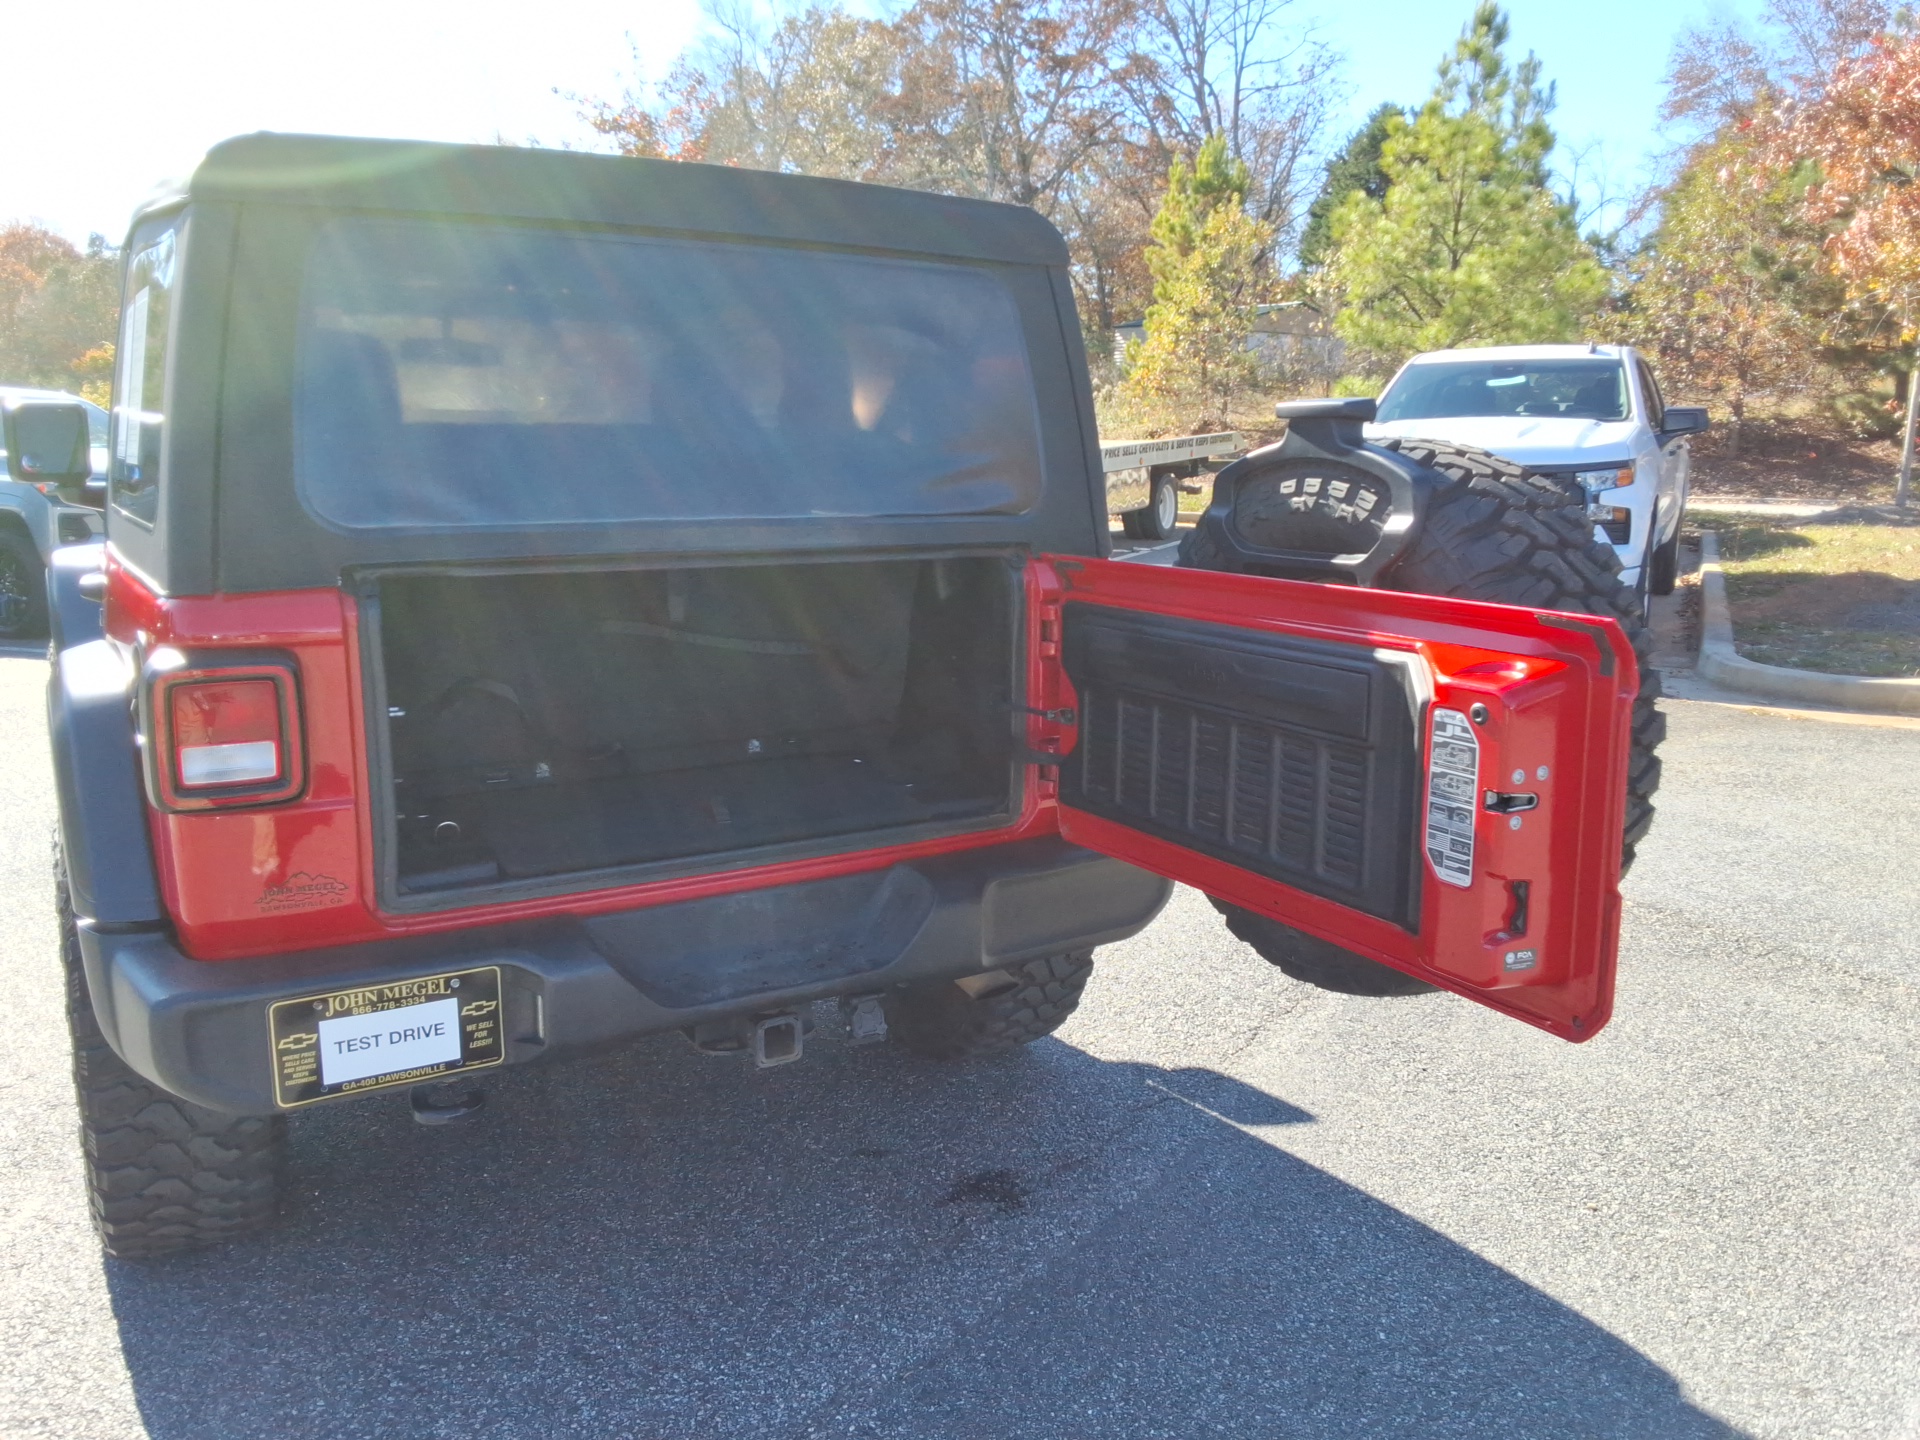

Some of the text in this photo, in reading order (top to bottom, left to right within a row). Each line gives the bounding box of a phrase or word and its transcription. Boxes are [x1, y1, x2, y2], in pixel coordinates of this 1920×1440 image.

[1104, 447, 1120, 459] PRICE
[1122, 444, 1137, 457] SELLS
[1139, 440, 1170, 454] CHEVROLETS
[1176, 438, 1194, 449] SERVICE
[1435, 724, 1472, 738] JL
[325, 978, 451, 1017] JOHN MEGEL
[352, 995, 426, 1015] 866-778-3334
[466, 1020, 494, 1032] WE SELL
[473, 1030, 488, 1039] FOR
[334, 1022, 446, 1055] TEST DRIVE
[378, 1063, 447, 1084] DAWSONVILLE
